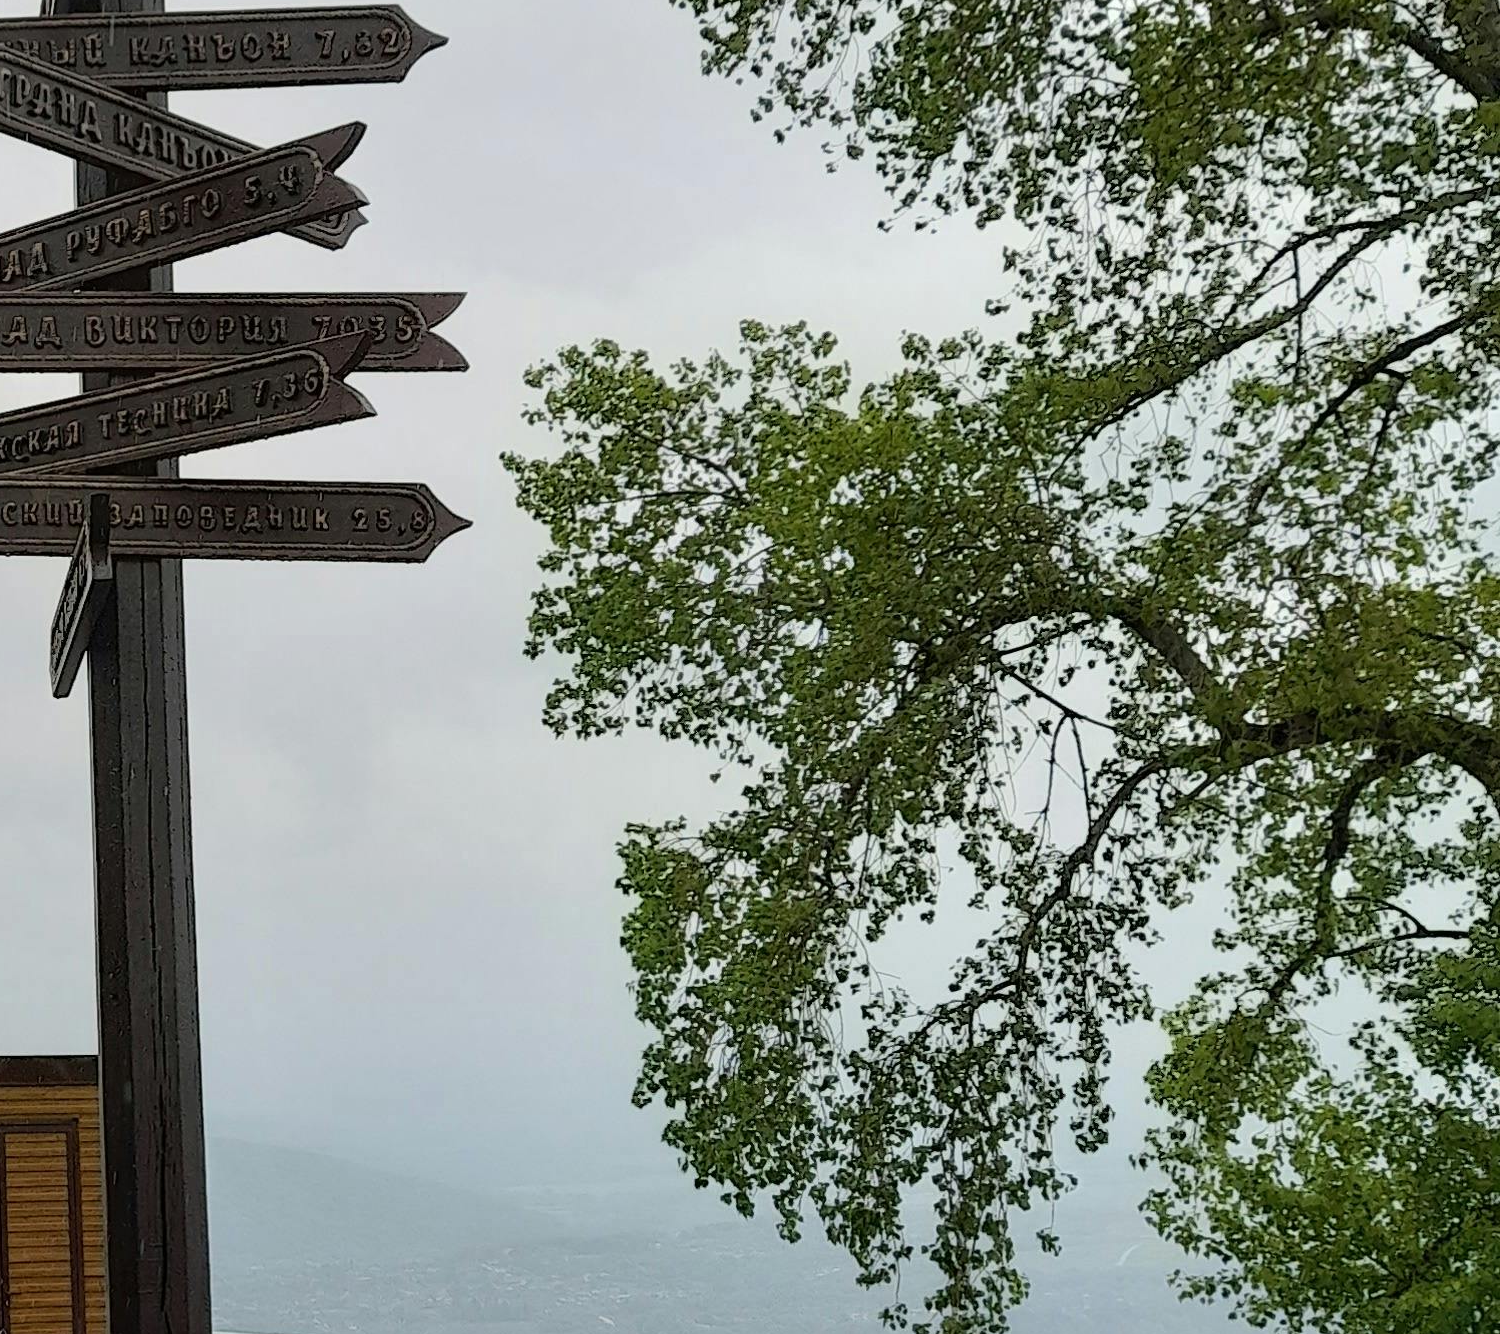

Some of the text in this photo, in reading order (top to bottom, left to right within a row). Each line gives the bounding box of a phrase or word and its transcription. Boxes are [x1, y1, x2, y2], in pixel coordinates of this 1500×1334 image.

[66, 188, 222, 263] РУФАБГО
[84, 313, 289, 348] ВИКТОРИЯ
[97, 386, 234, 439] ТЕСНИНА
[109, 503, 331, 535] ЗАПОВЕДНИК
[351, 507, 429, 537] 25,8
